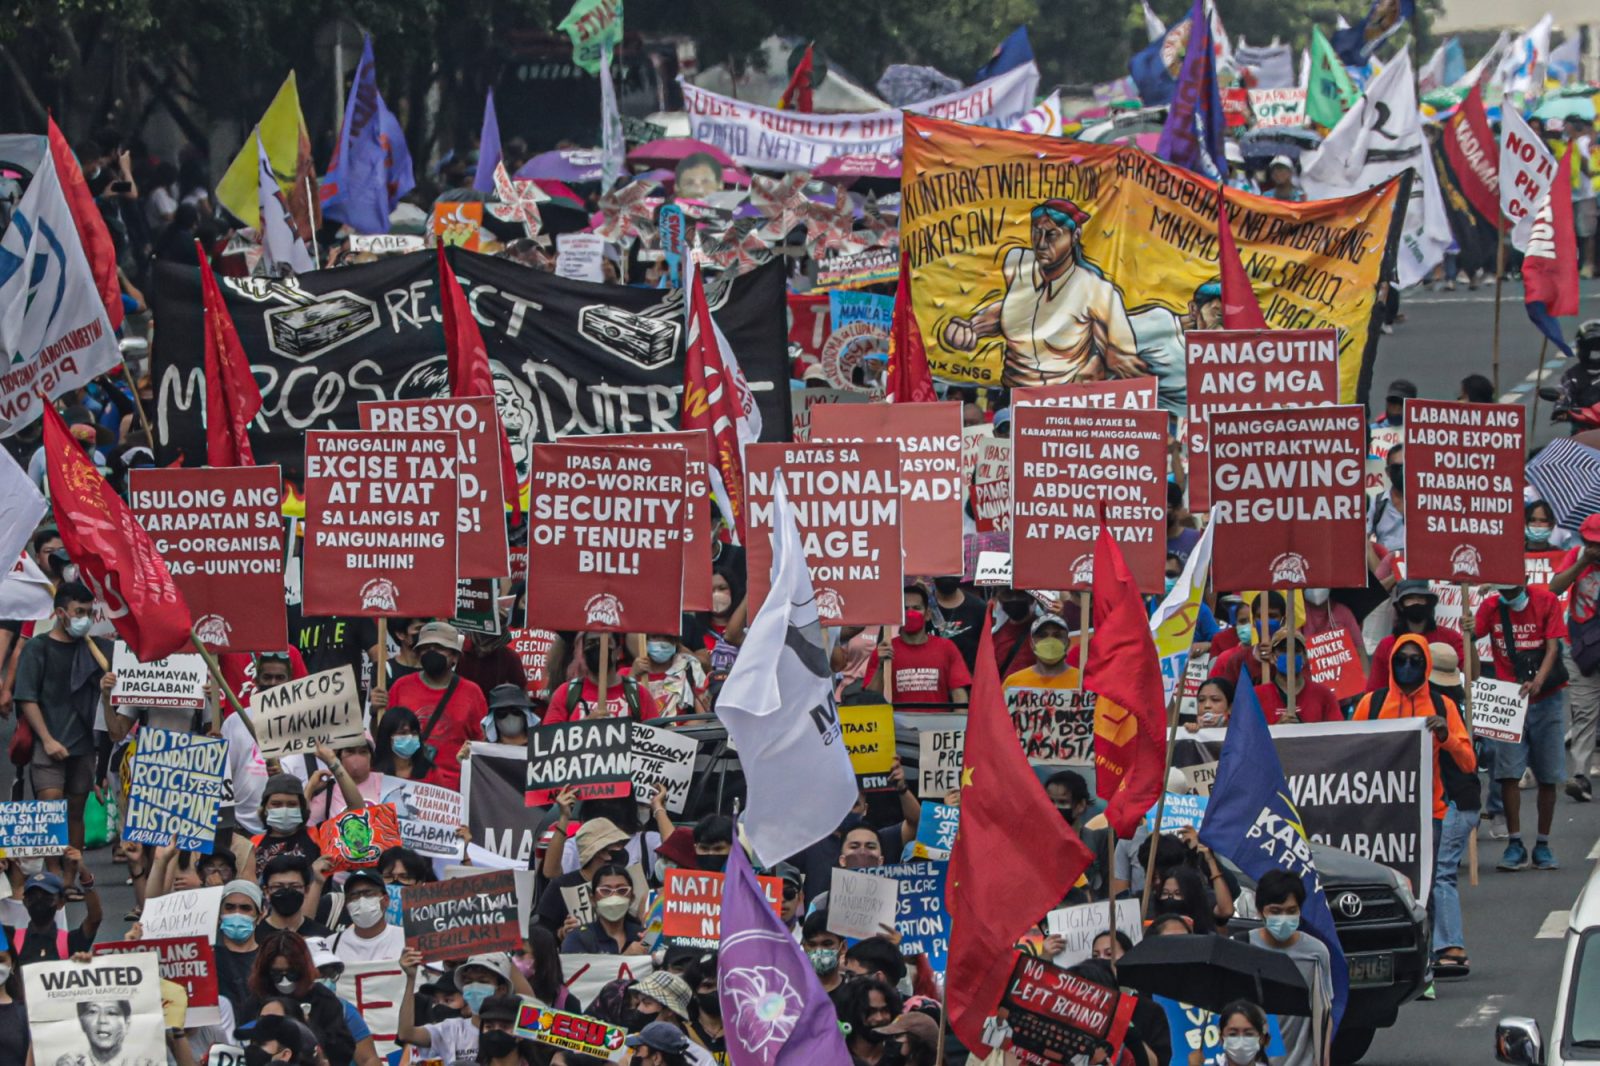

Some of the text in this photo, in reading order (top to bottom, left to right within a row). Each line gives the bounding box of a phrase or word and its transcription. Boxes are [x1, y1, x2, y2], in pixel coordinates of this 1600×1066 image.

[1506, 132, 1535, 162] NO
[1514, 170, 1540, 201] PH
[1238, 210, 1268, 241] NA
[1149, 205, 1243, 262] MINIMU
[1245, 252, 1277, 283] NA
[1189, 340, 1335, 365] PANAGUTIN
[1200, 370, 1323, 394] ANG MGA
[157, 359, 386, 446] MRCOS
[1123, 389, 1152, 409] AT
[370, 405, 486, 433] PRESYO,
[1046, 416, 1137, 428] ITIGIL ANG ATAKE SA
[1214, 417, 1360, 436] MANGGAGAWANG
[1411, 407, 1519, 427] LABANAN ANG
[1021, 428, 1161, 440] KARAPATAN NG MANGGAGAWA:
[1408, 429, 1458, 446] LABOR
[1463, 432, 1522, 449] EXPORT
[317, 438, 406, 452] TANGGALIN
[411, 438, 446, 453] ANG
[1042, 443, 1140, 460] ITIGIL ANG
[1215, 438, 1360, 459] KONTRAKTWAL,
[567, 455, 652, 472] IPASA ANG
[785, 448, 860, 464] BATAS SA
[1434, 452, 1495, 469] POLICY!
[307, 456, 456, 479] EXCISE TAX
[1023, 462, 1158, 484] RED-TAGGING,
[1215, 459, 1361, 491] GAWING
[1417, 472, 1513, 493] TRABAHO SA
[132, 487, 279, 510] ISULONG ANG
[328, 482, 361, 504] AT
[369, 482, 434, 504] EVAT
[1033, 483, 1148, 503] ABDUCTION,
[535, 494, 681, 524] SECURITY
[750, 499, 897, 527] MNIMUM
[1015, 502, 1070, 518] ILIGAL
[1073, 503, 1096, 518] NA
[1218, 495, 1361, 524] REGULAR!
[1417, 494, 1512, 514] PINAS, HINDI
[255, 511, 281, 528] SA
[322, 510, 439, 526] SA LANGIS AT
[1427, 516, 1504, 535] SA LABAS!
[316, 531, 445, 548] PANGUNAHING
[533, 525, 566, 547] OF
[1026, 523, 1049, 538] AT
[156, 536, 281, 553] G-OORGANISA
[768, 532, 880, 561] AGE,
[346, 553, 414, 569] BILIHIN!
[579, 550, 640, 574] BILL!
[849, 566, 880, 580] NA!
[1272, 570, 1306, 585] KMU
[362, 597, 396, 611] KMU
[587, 611, 621, 626] KMU
[117, 669, 201, 684] MAMAMAYAN,
[1471, 681, 1497, 692] TOP
[122, 682, 195, 694] IPAGLABAN!
[261, 671, 345, 712] MARCOS
[117, 697, 198, 707] KILUSANG MAYO UNO
[1492, 706, 1517, 717] AND
[266, 702, 350, 739] ITAKWIL!
[138, 728, 190, 753] NO TO
[533, 723, 626, 757] LABAN
[143, 741, 229, 775] MANDATORY
[641, 758, 665, 775] THE
[134, 762, 188, 791] ROTC!
[527, 751, 632, 786] KABATAAN
[413, 785, 462, 804] KABUHAYAN
[415, 797, 461, 815] TIRAHAN AT
[19, 815, 33, 825] SA
[127, 798, 198, 837] HISTORY
[14, 824, 48, 835] BALIK
[3, 834, 59, 846] ESKWELA
[12, 847, 28, 856] KPL
[410, 892, 519, 922] KONTRAKTWAL
[920, 897, 940, 912] TO
[433, 912, 506, 932] GAWING
[40, 967, 143, 991] WANTED
[1024, 959, 1113, 1010] NO STUDENT
[1010, 978, 1053, 1005] LEFT
